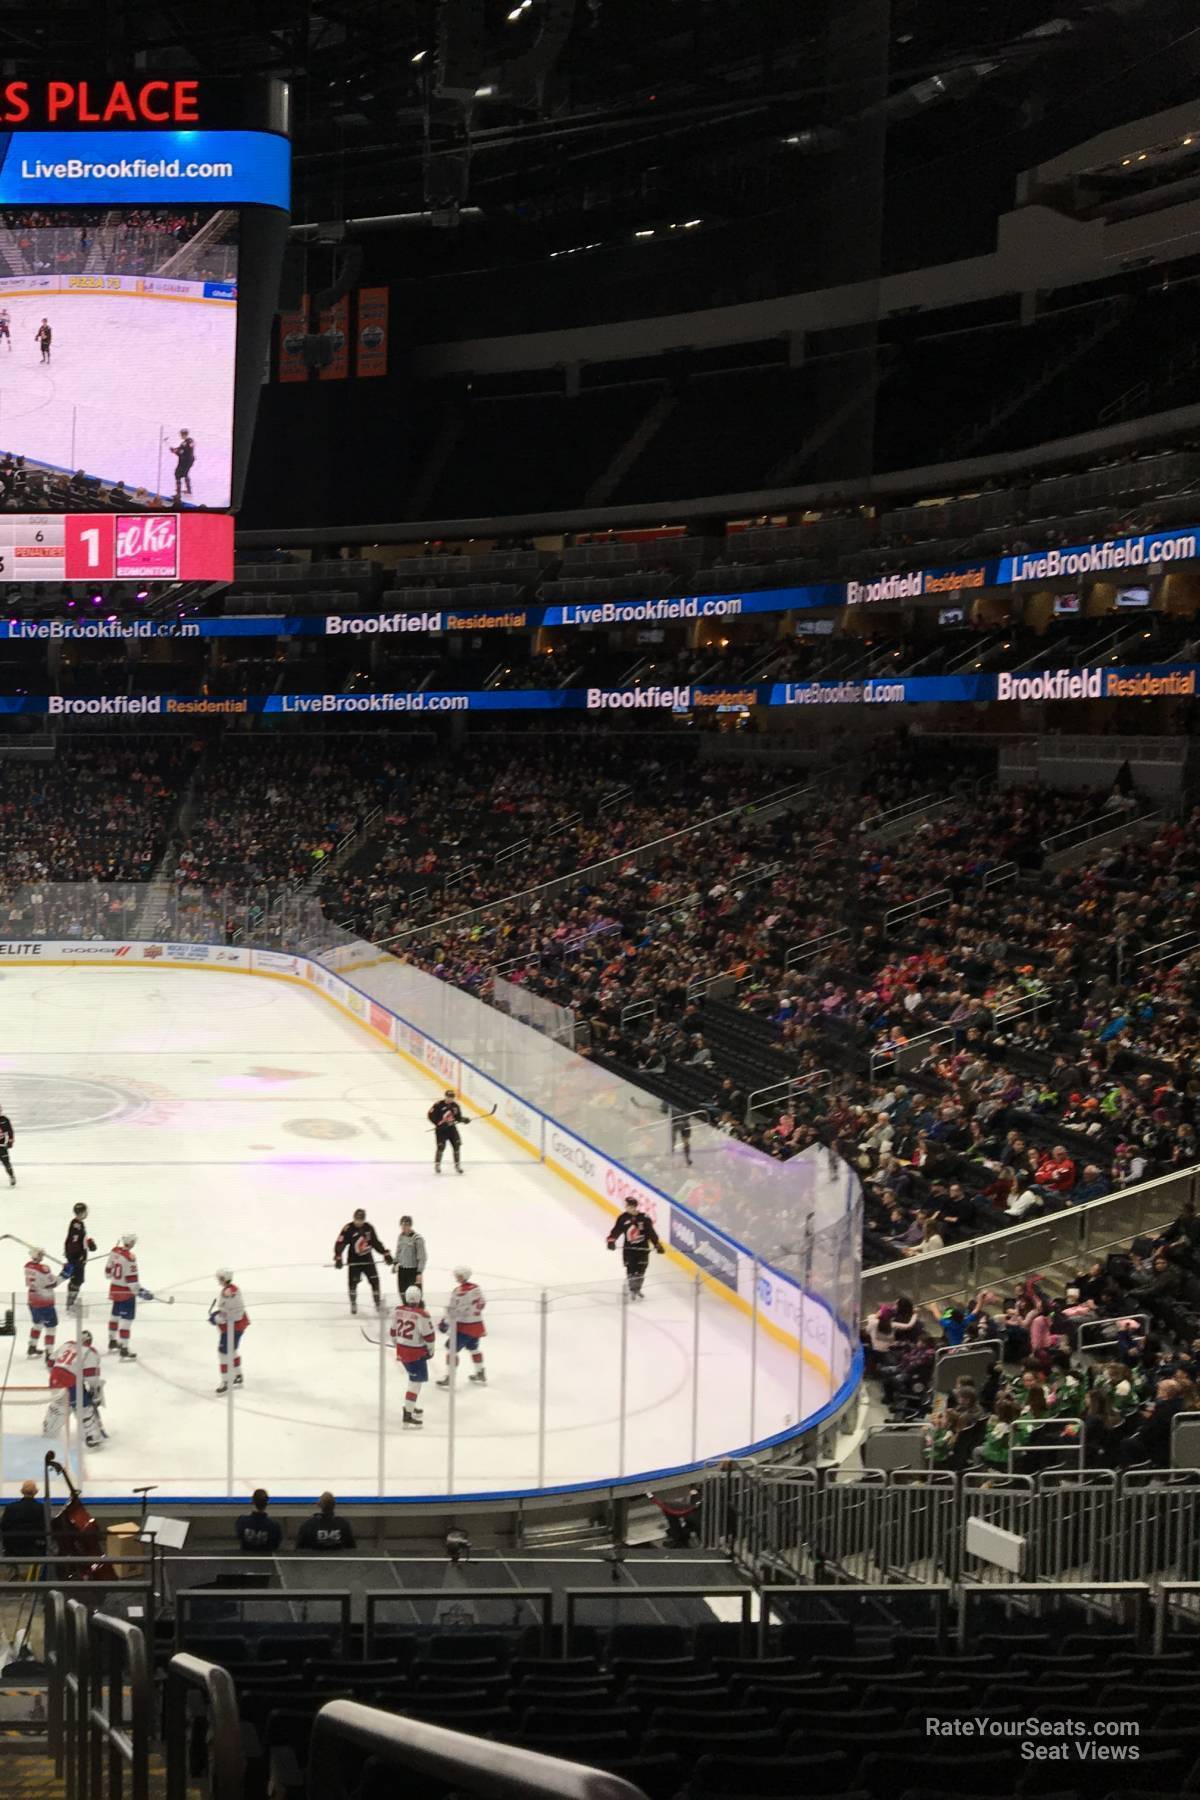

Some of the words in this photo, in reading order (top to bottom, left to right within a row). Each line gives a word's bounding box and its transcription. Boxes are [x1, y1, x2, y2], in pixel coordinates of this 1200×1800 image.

[48, 81, 200, 121] PLACE
[21, 158, 233, 180] LiveBrookfield.com
[69, 276, 104, 289] PIZZA
[35, 531, 44, 543] 6
[80, 528, 99, 567] 1
[16, 548, 64, 557] PENALTIES
[1012, 534, 1196, 582] LiveBrookfield.com
[925, 566, 986, 593] Residential
[562, 597, 743, 625] LiveBrookfield.com
[325, 613, 441, 635] Brookfield
[447, 612, 526, 630] Residential
[997, 668, 1102, 701] Brookfield
[1106, 670, 1196, 698] Residential
[49, 696, 161, 714] Brookfield
[166, 699, 248, 714] Residential
[282, 693, 469, 713] LiveBrookfield.com
[587, 686, 690, 709] Brookfield
[693, 688, 758, 706] Residential
